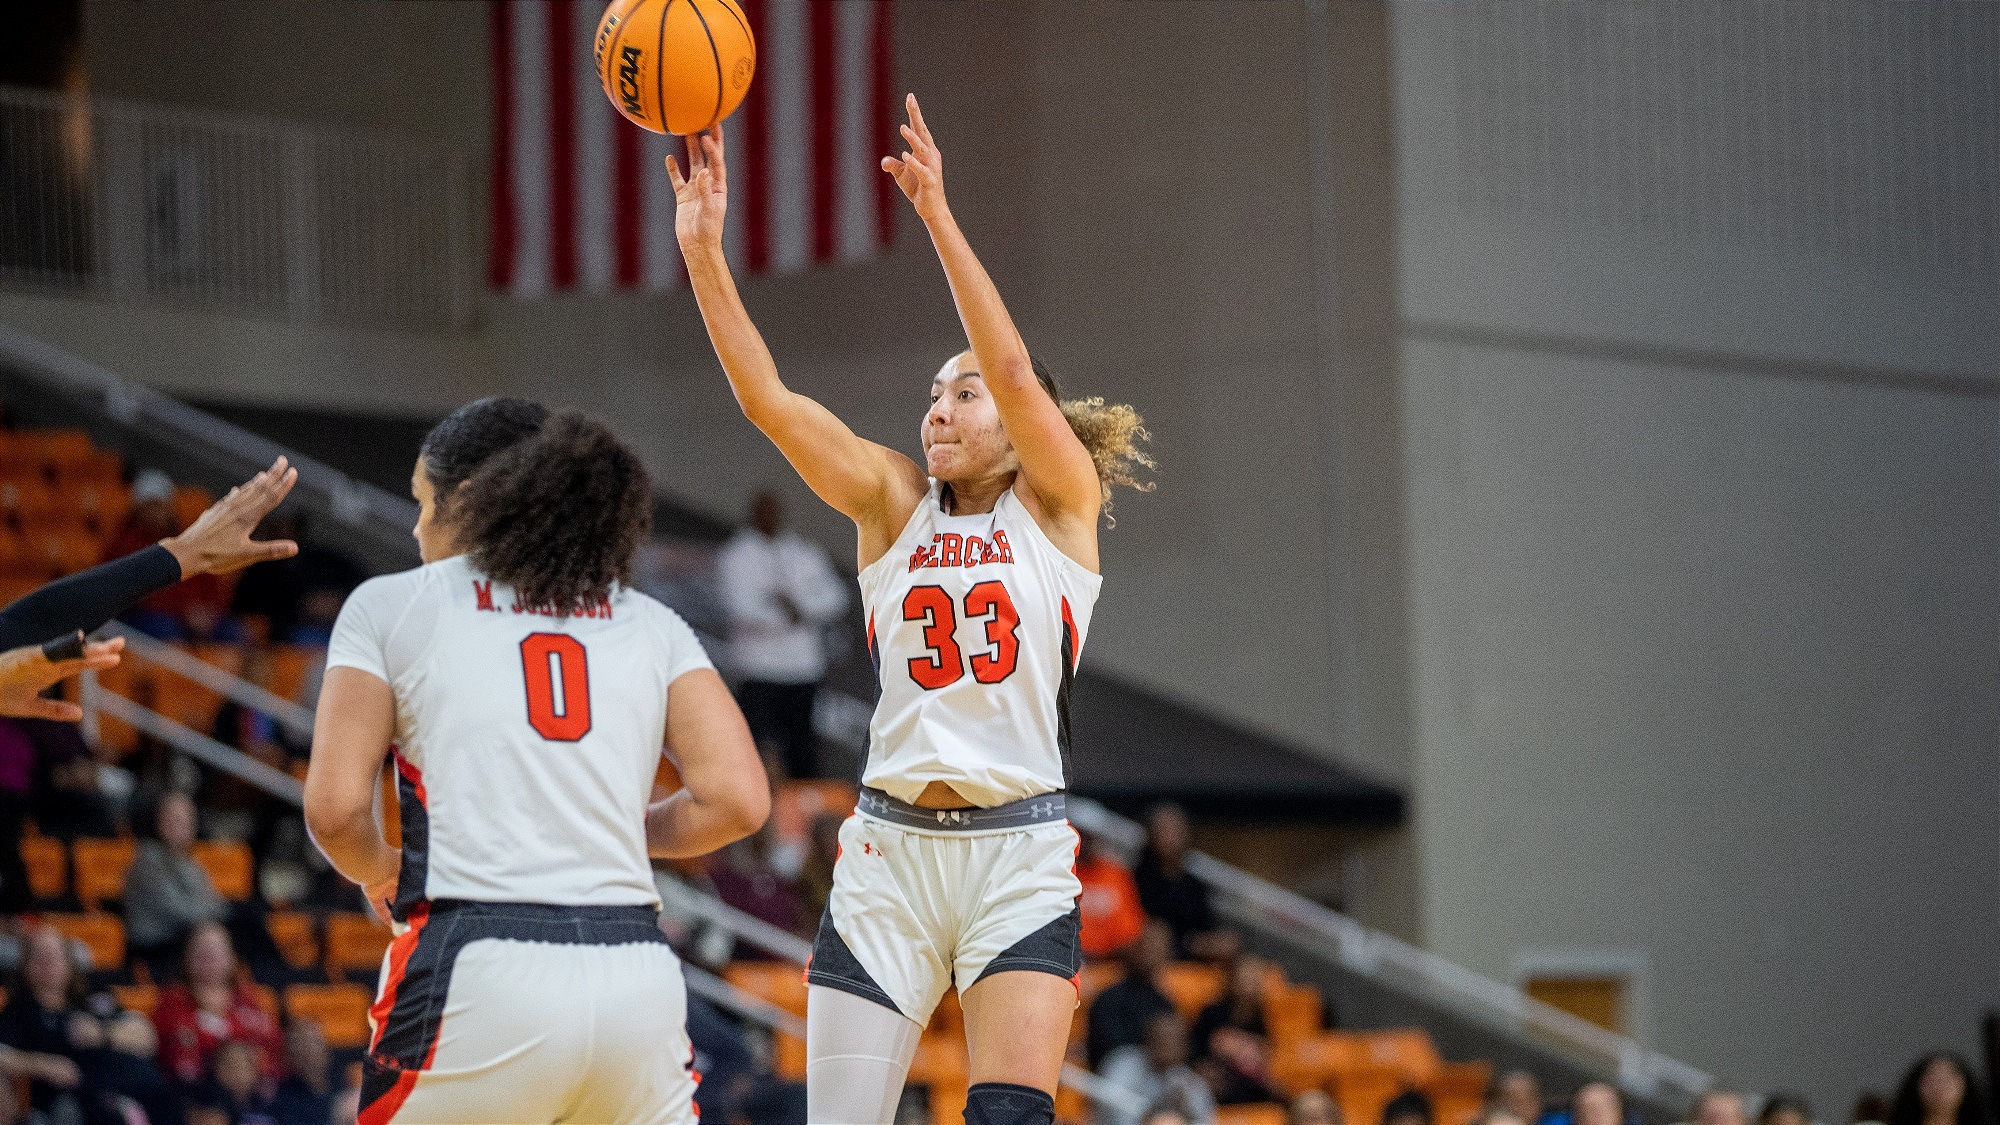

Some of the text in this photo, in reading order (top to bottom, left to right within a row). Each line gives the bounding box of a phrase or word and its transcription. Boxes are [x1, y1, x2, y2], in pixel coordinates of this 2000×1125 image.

[620, 45, 646, 120] NCAA
[519, 632, 592, 743] 0
[902, 579, 1021, 691] 33
